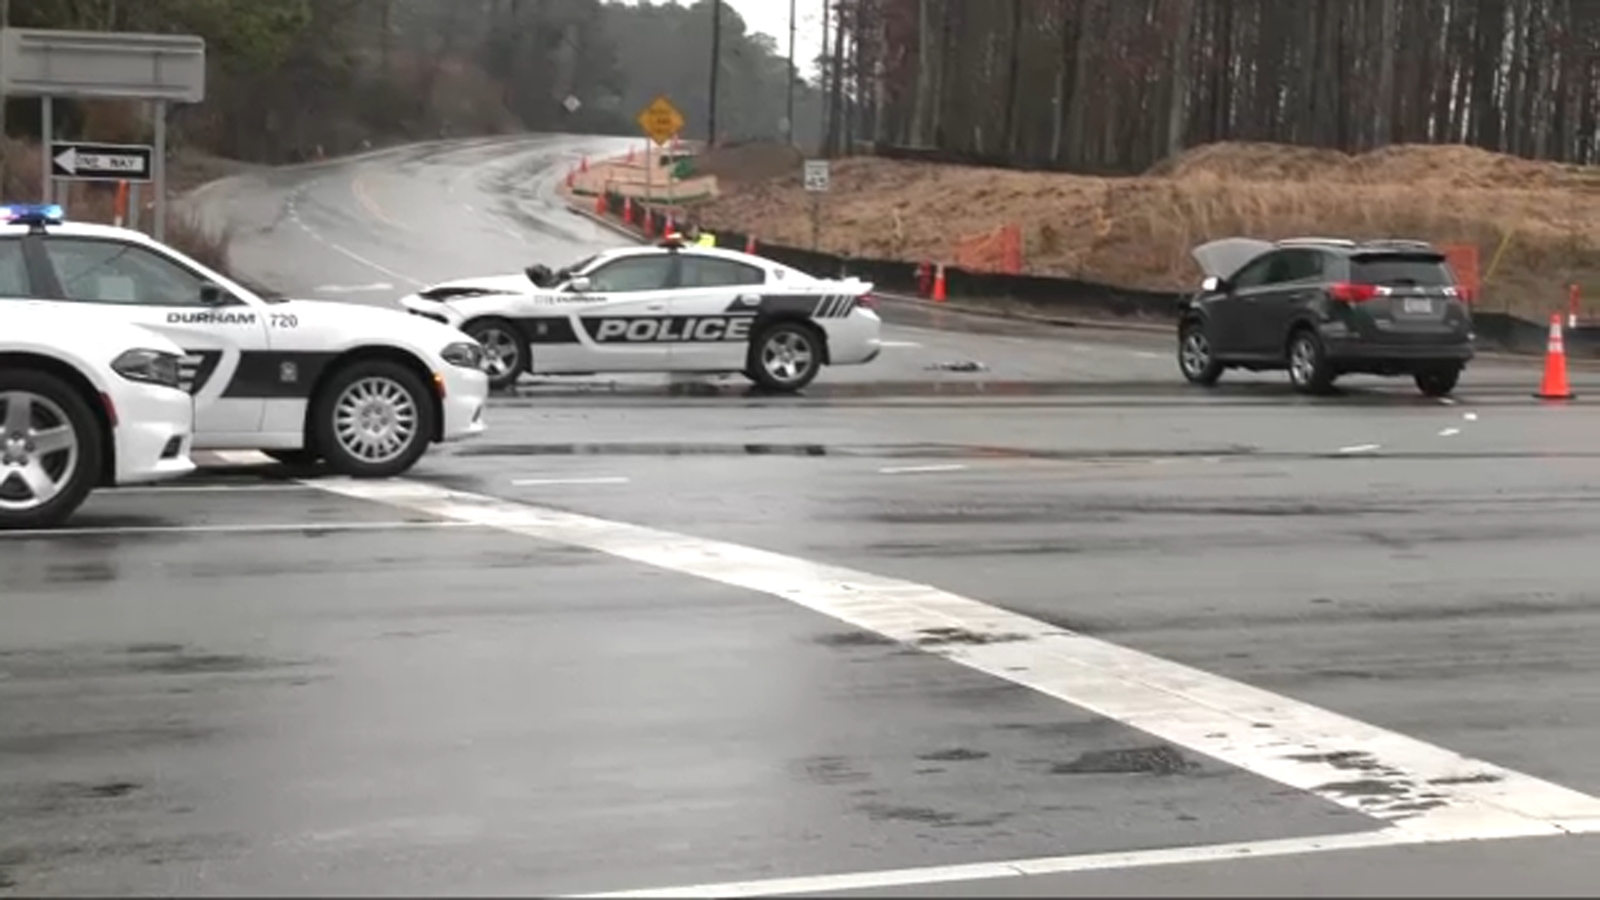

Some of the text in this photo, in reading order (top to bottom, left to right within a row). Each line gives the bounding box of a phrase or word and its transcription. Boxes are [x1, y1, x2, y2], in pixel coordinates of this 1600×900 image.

[109, 158, 135, 168] WAY
[166, 312, 299, 328] DURHAM 720
[595, 317, 754, 341] POLICE
